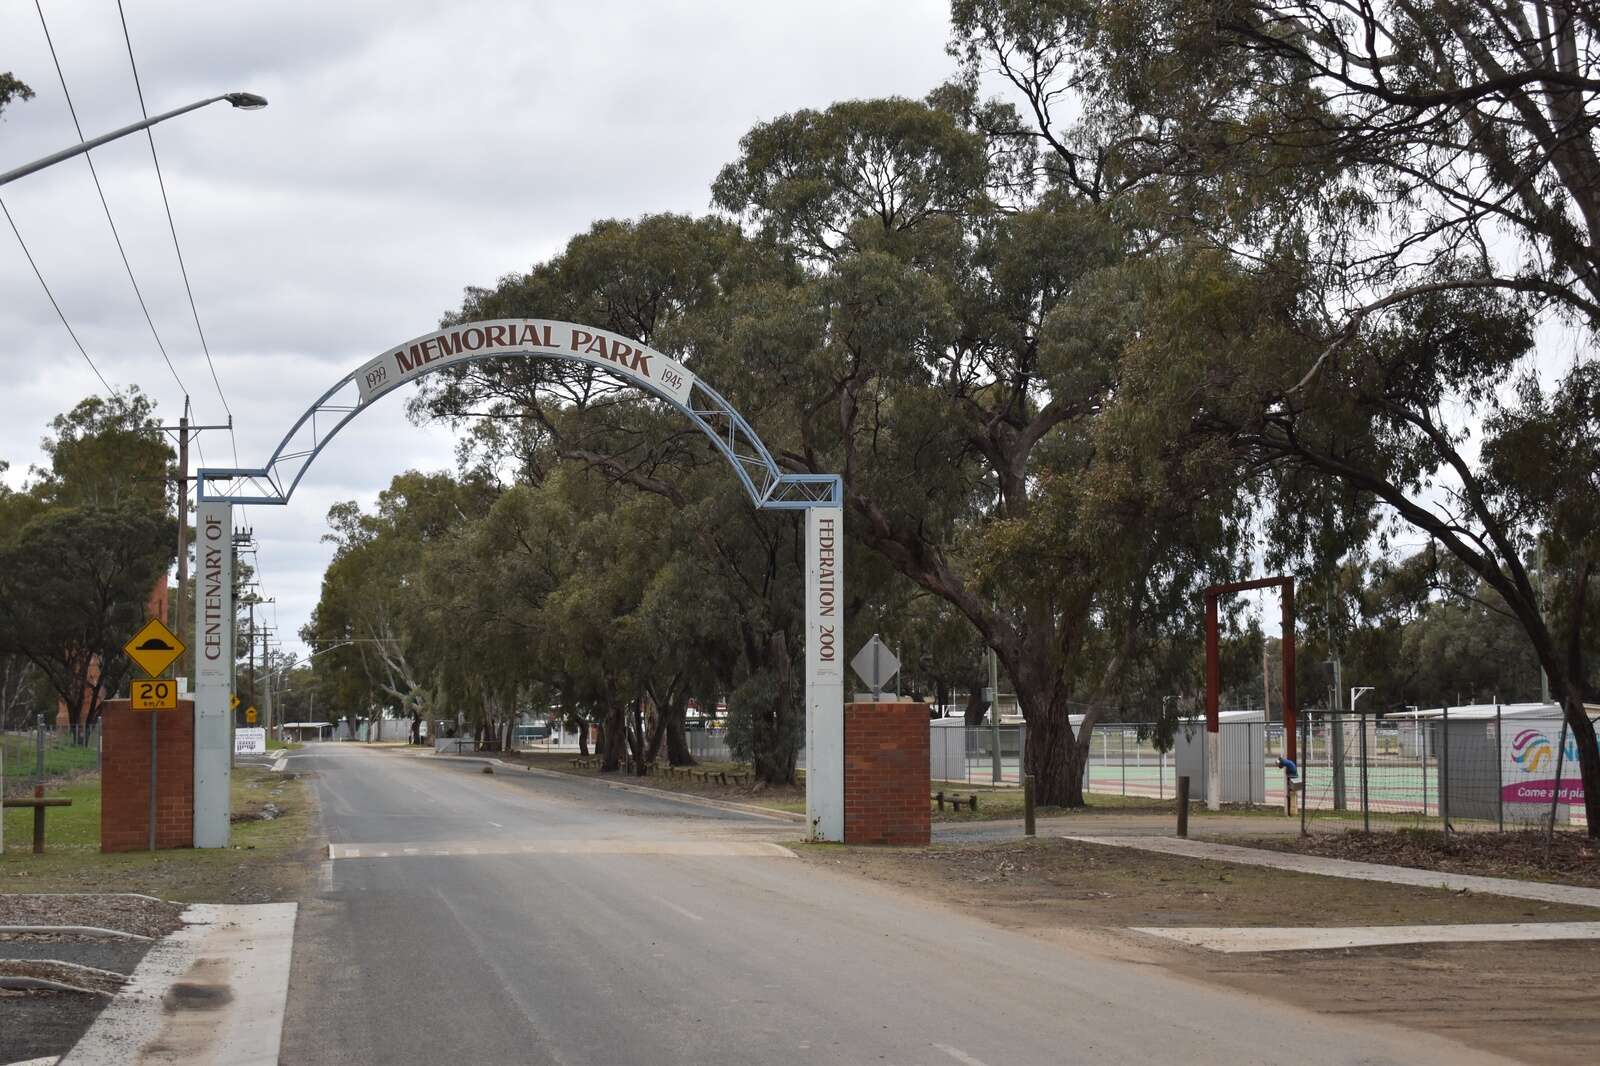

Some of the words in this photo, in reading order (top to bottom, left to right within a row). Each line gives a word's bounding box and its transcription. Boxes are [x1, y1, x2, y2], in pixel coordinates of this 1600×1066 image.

[394, 324, 561, 374] MEMORIAL
[570, 329, 655, 377] PARK
[365, 366, 387, 389] 1939
[661, 368, 683, 390] 1945
[205, 514, 222, 541] OF
[819, 518, 835, 617] FEDERATION
[205, 545, 222, 661] CENTENARY
[819, 624, 835, 662] 2001
[140, 683, 168, 699] 20
[1518, 786, 1547, 798] Come
